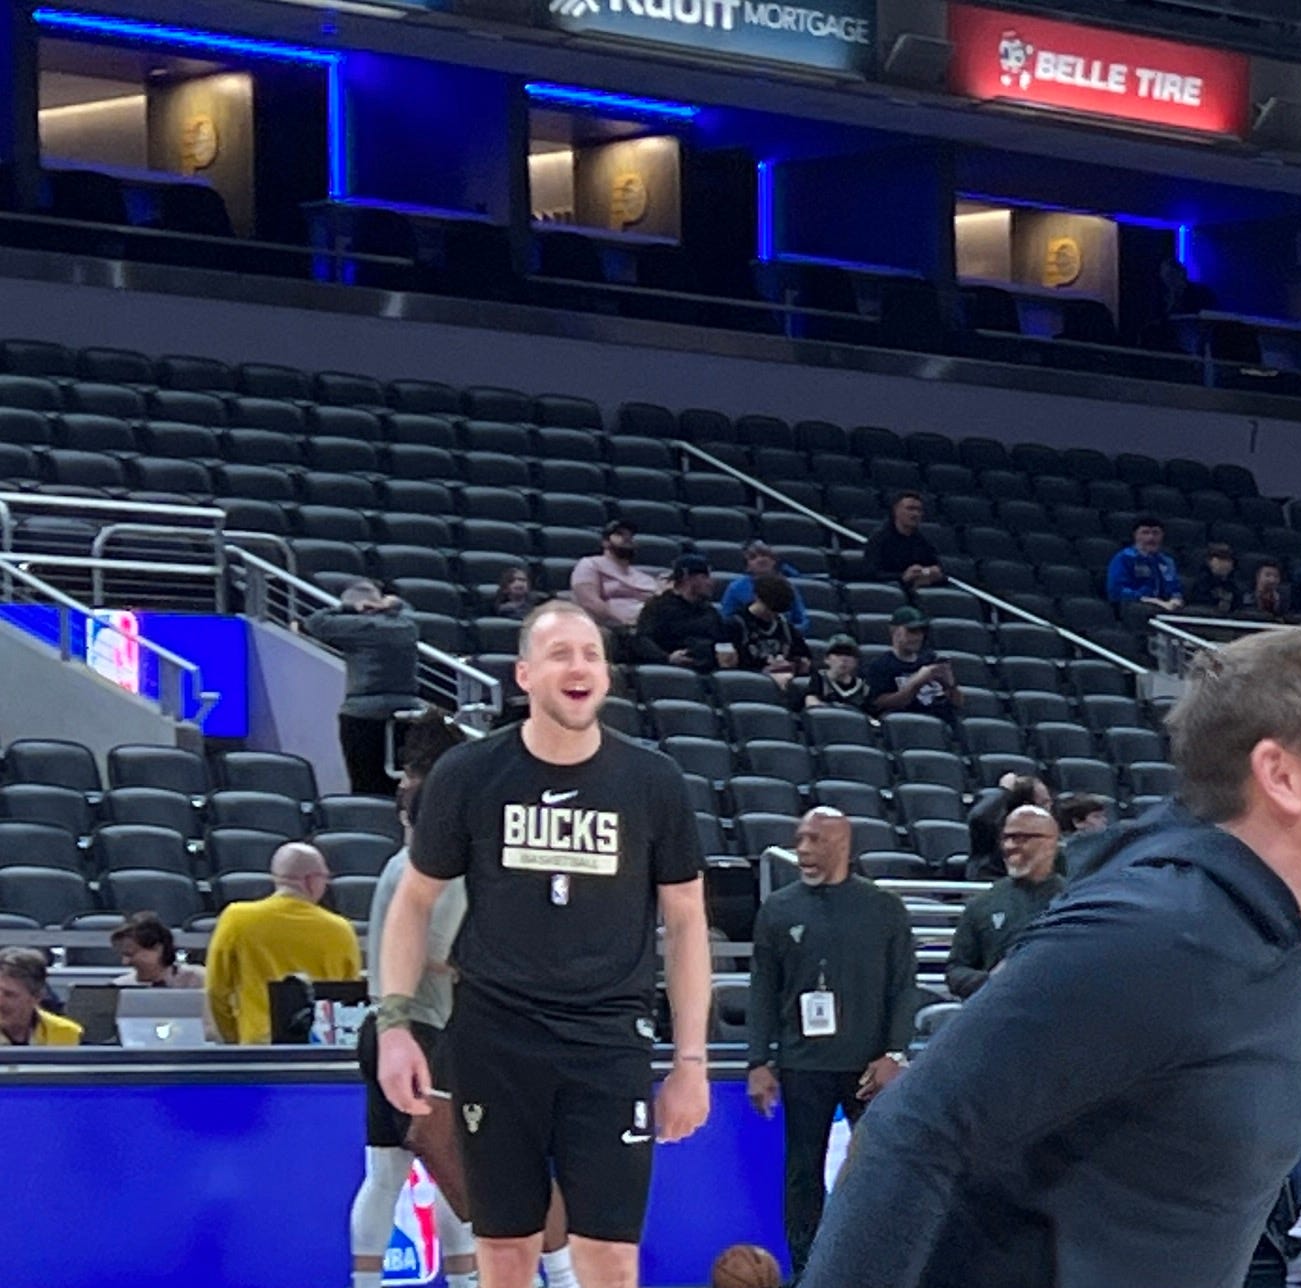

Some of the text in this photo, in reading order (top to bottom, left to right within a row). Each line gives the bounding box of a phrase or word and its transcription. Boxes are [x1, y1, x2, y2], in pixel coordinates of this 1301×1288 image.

[743, 4, 870, 44] MORTGAGE
[1035, 50, 1204, 106] BELLE TIRE
[503, 803, 619, 853] BUCKS
